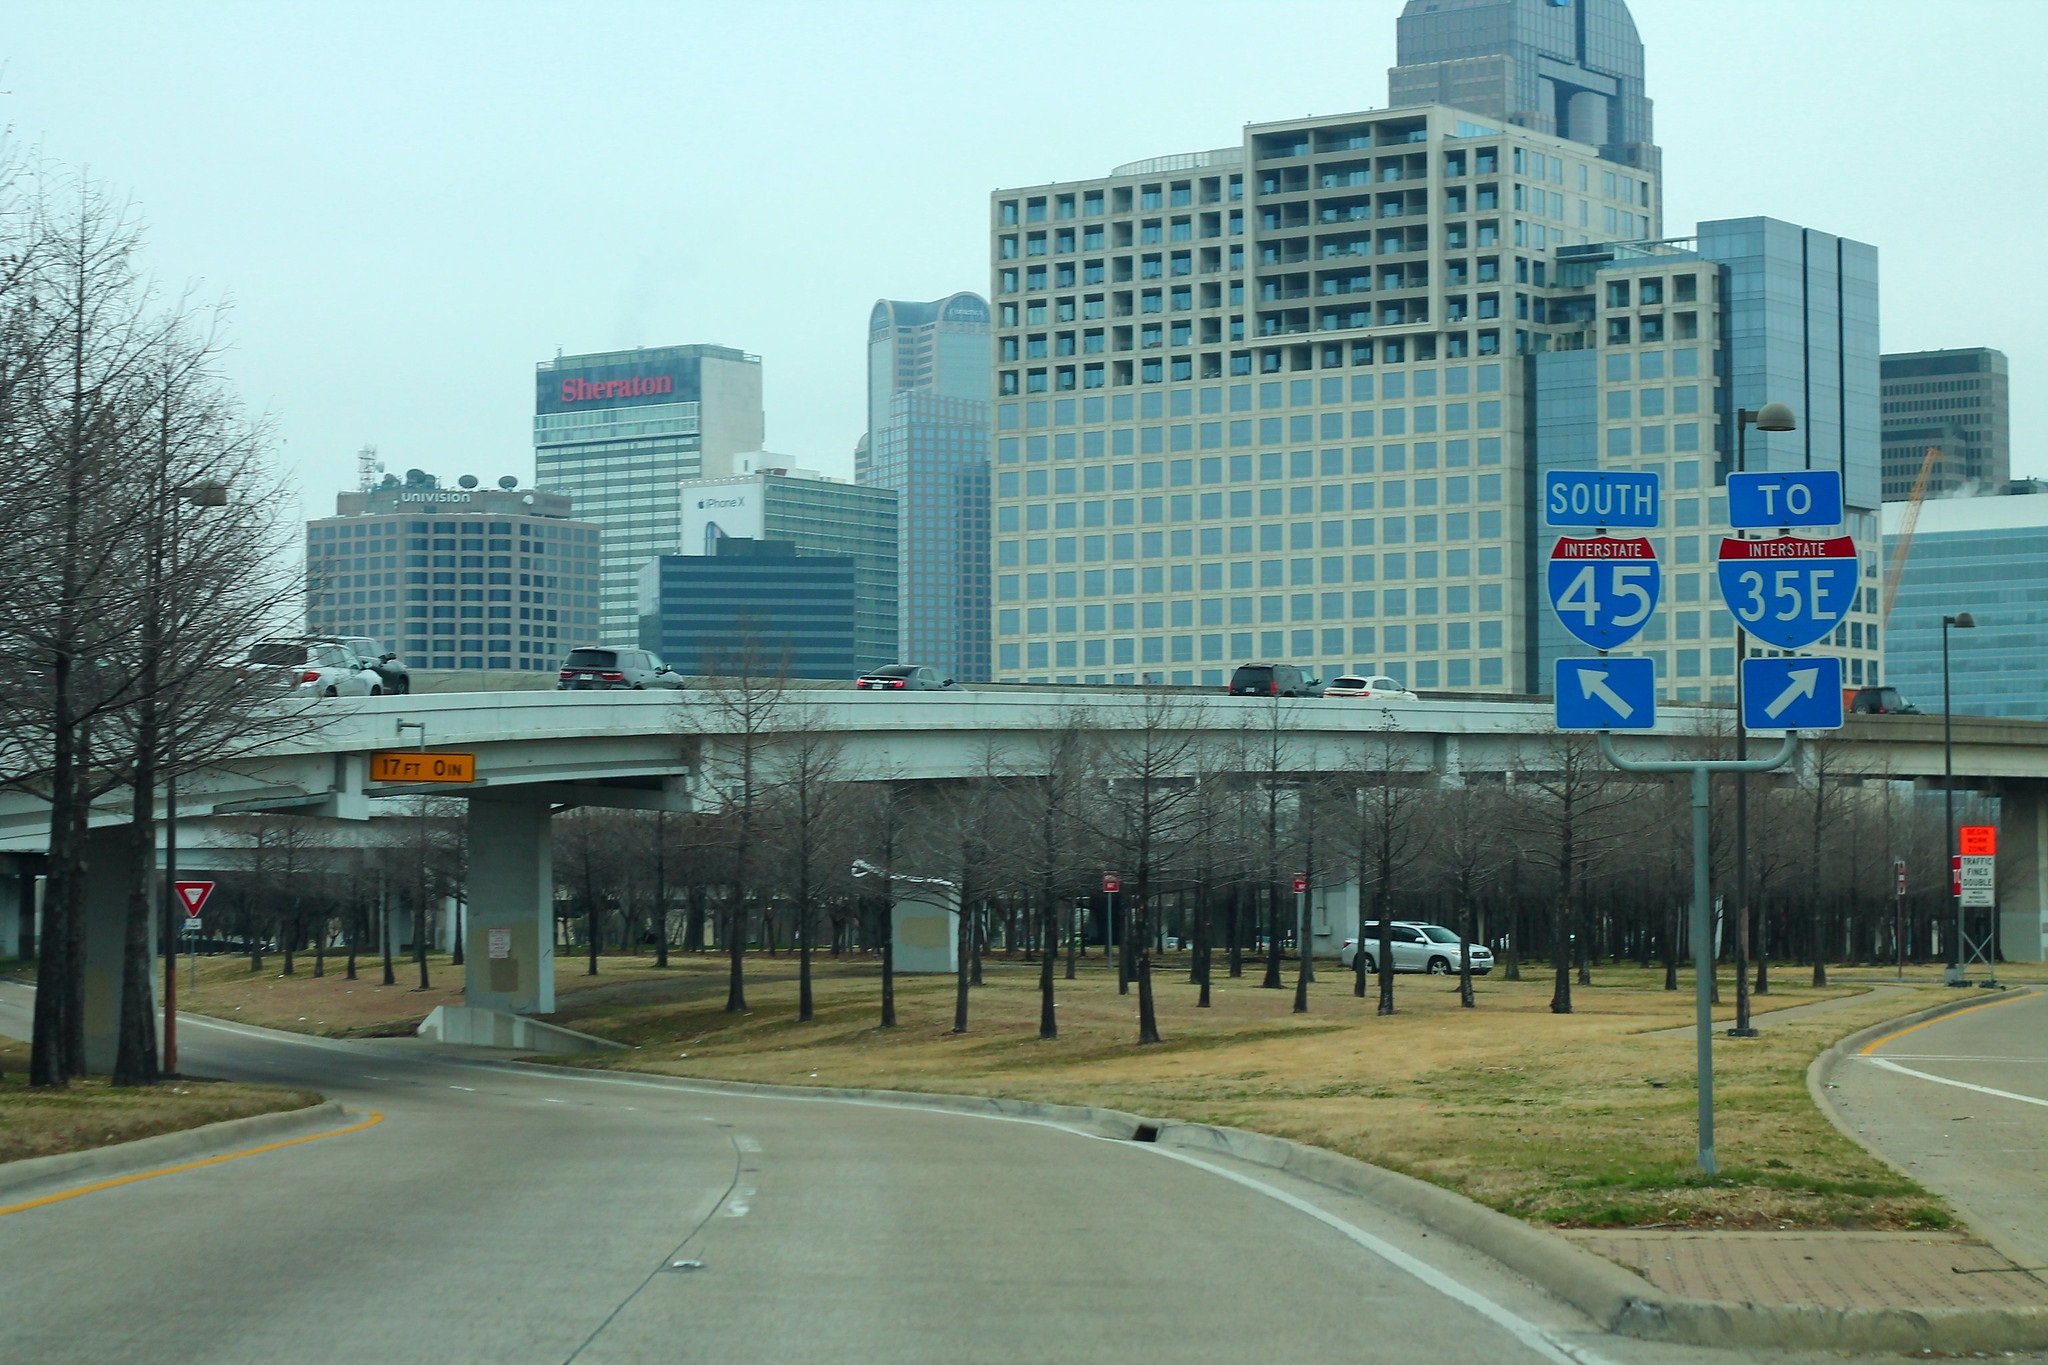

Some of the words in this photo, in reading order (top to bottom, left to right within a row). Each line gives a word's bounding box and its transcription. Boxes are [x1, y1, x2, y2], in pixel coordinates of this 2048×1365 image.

[561, 375, 672, 402] Sheraton
[737, 495, 746, 507] X
[1550, 482, 1653, 516] SOUTH
[1757, 483, 1812, 516] TO
[1564, 543, 1642, 557] INTERSTATE
[1748, 542, 1826, 557] INTERSTATE
[1556, 565, 1651, 627] 45
[1738, 569, 1837, 622] 35E
[383, 758, 400, 776] 17
[404, 763, 421, 776] FT
[434, 759, 446, 776] 0
[447, 764, 462, 776] IN
[1963, 857, 1992, 866] TRAFFIC
[1967, 867, 1988, 876] FINES
[1963, 878, 1992, 887] DOUBLE
